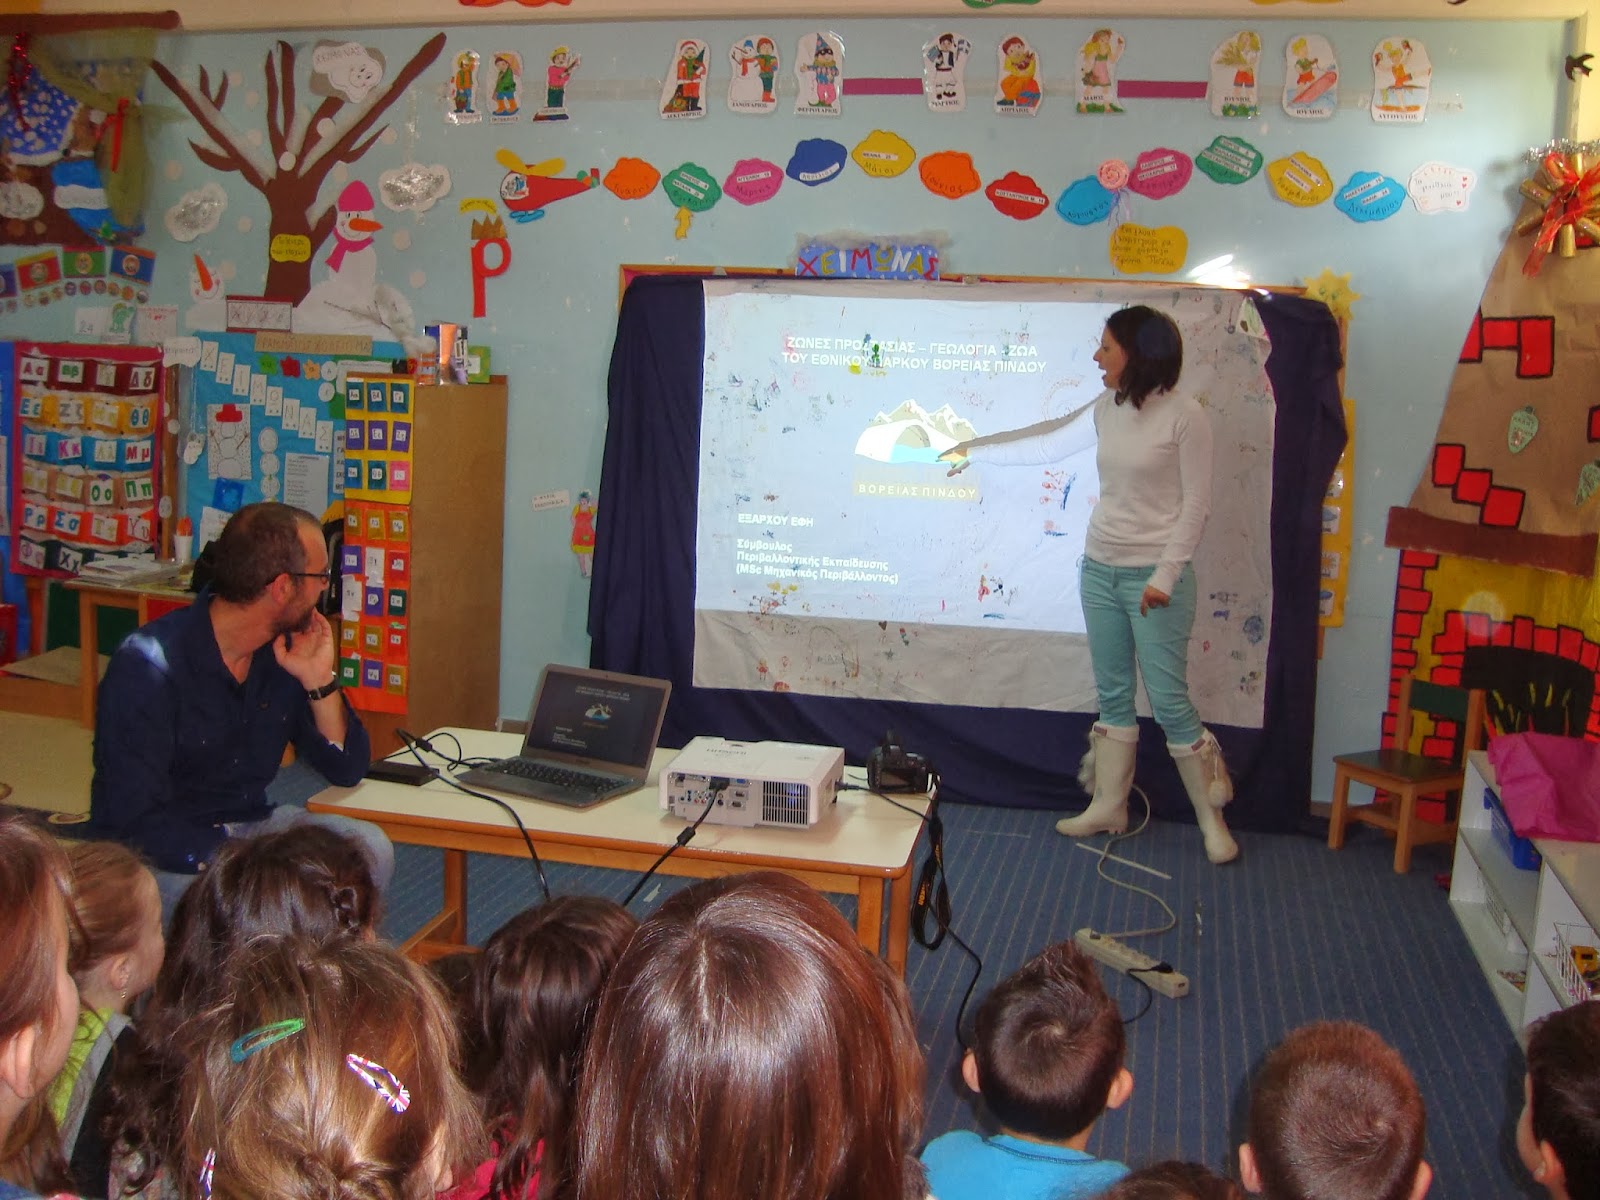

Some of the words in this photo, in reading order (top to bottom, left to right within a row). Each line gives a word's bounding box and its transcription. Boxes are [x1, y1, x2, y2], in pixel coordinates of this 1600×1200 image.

[787, 337, 831, 350] ΖΩΝΕΣ
[929, 342, 997, 356] ΓΕΩΛΟΓΙΑ
[1008, 344, 1038, 357] ΖΩΑ
[782, 352, 808, 364] ΤΟΥ
[811, 353, 869, 367] ΕΘΝΙΚΟΥ
[873, 356, 930, 370] ΠΑΡΚΟΥ
[933, 358, 991, 372] ΒΟΡΕΙΑΣ
[994, 360, 1047, 373] ΠΙΝΔΟΥ
[858, 484, 919, 496] ΒΟΡΕΙΑΣ
[922, 487, 976, 499] ΠΙΝΔΟΥ
[737, 513, 788, 526] ΕΞΑΡΧΟΥ
[791, 516, 814, 527] ΕΦΗ
[736, 551, 820, 567] Περιβαλλοντικής
[822, 556, 889, 572] Εκπαίδευσης
[764, 566, 818, 580] Μηχανικός
[820, 568, 899, 585] Περιβάλλοντος)
